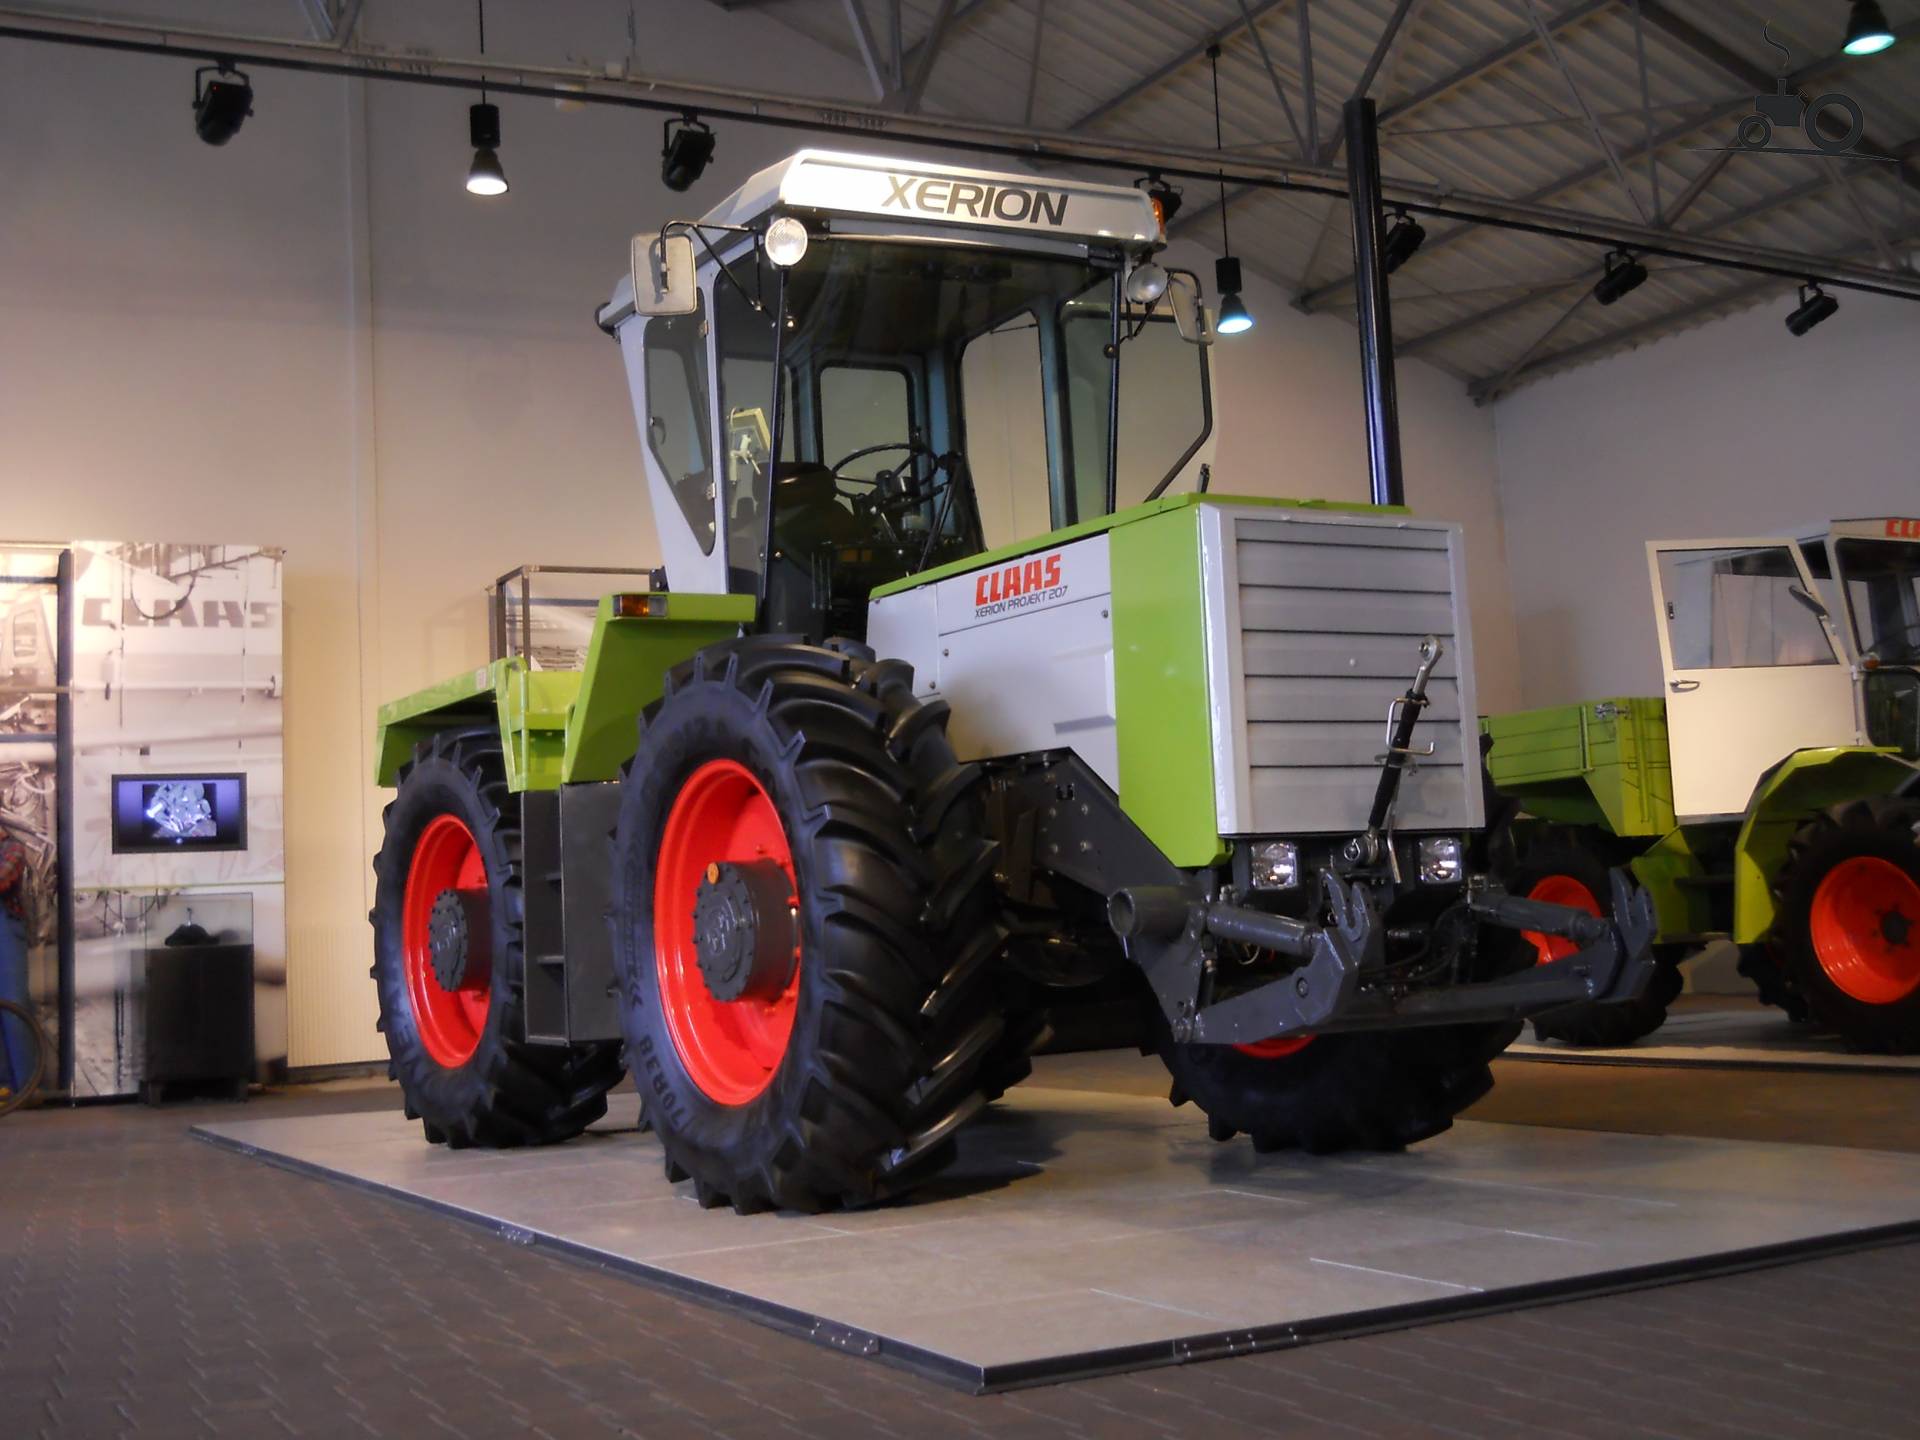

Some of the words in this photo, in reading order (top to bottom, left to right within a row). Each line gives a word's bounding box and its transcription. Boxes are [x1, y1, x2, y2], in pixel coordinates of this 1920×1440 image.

[881, 175, 1069, 227] XERION
[976, 554, 1061, 606] CLAAS
[82, 598, 279, 629] CLAAS
[975, 602, 1006, 618] XERION
[1007, 590, 1047, 610] PROJEKT
[1048, 585, 1068, 600] 207
